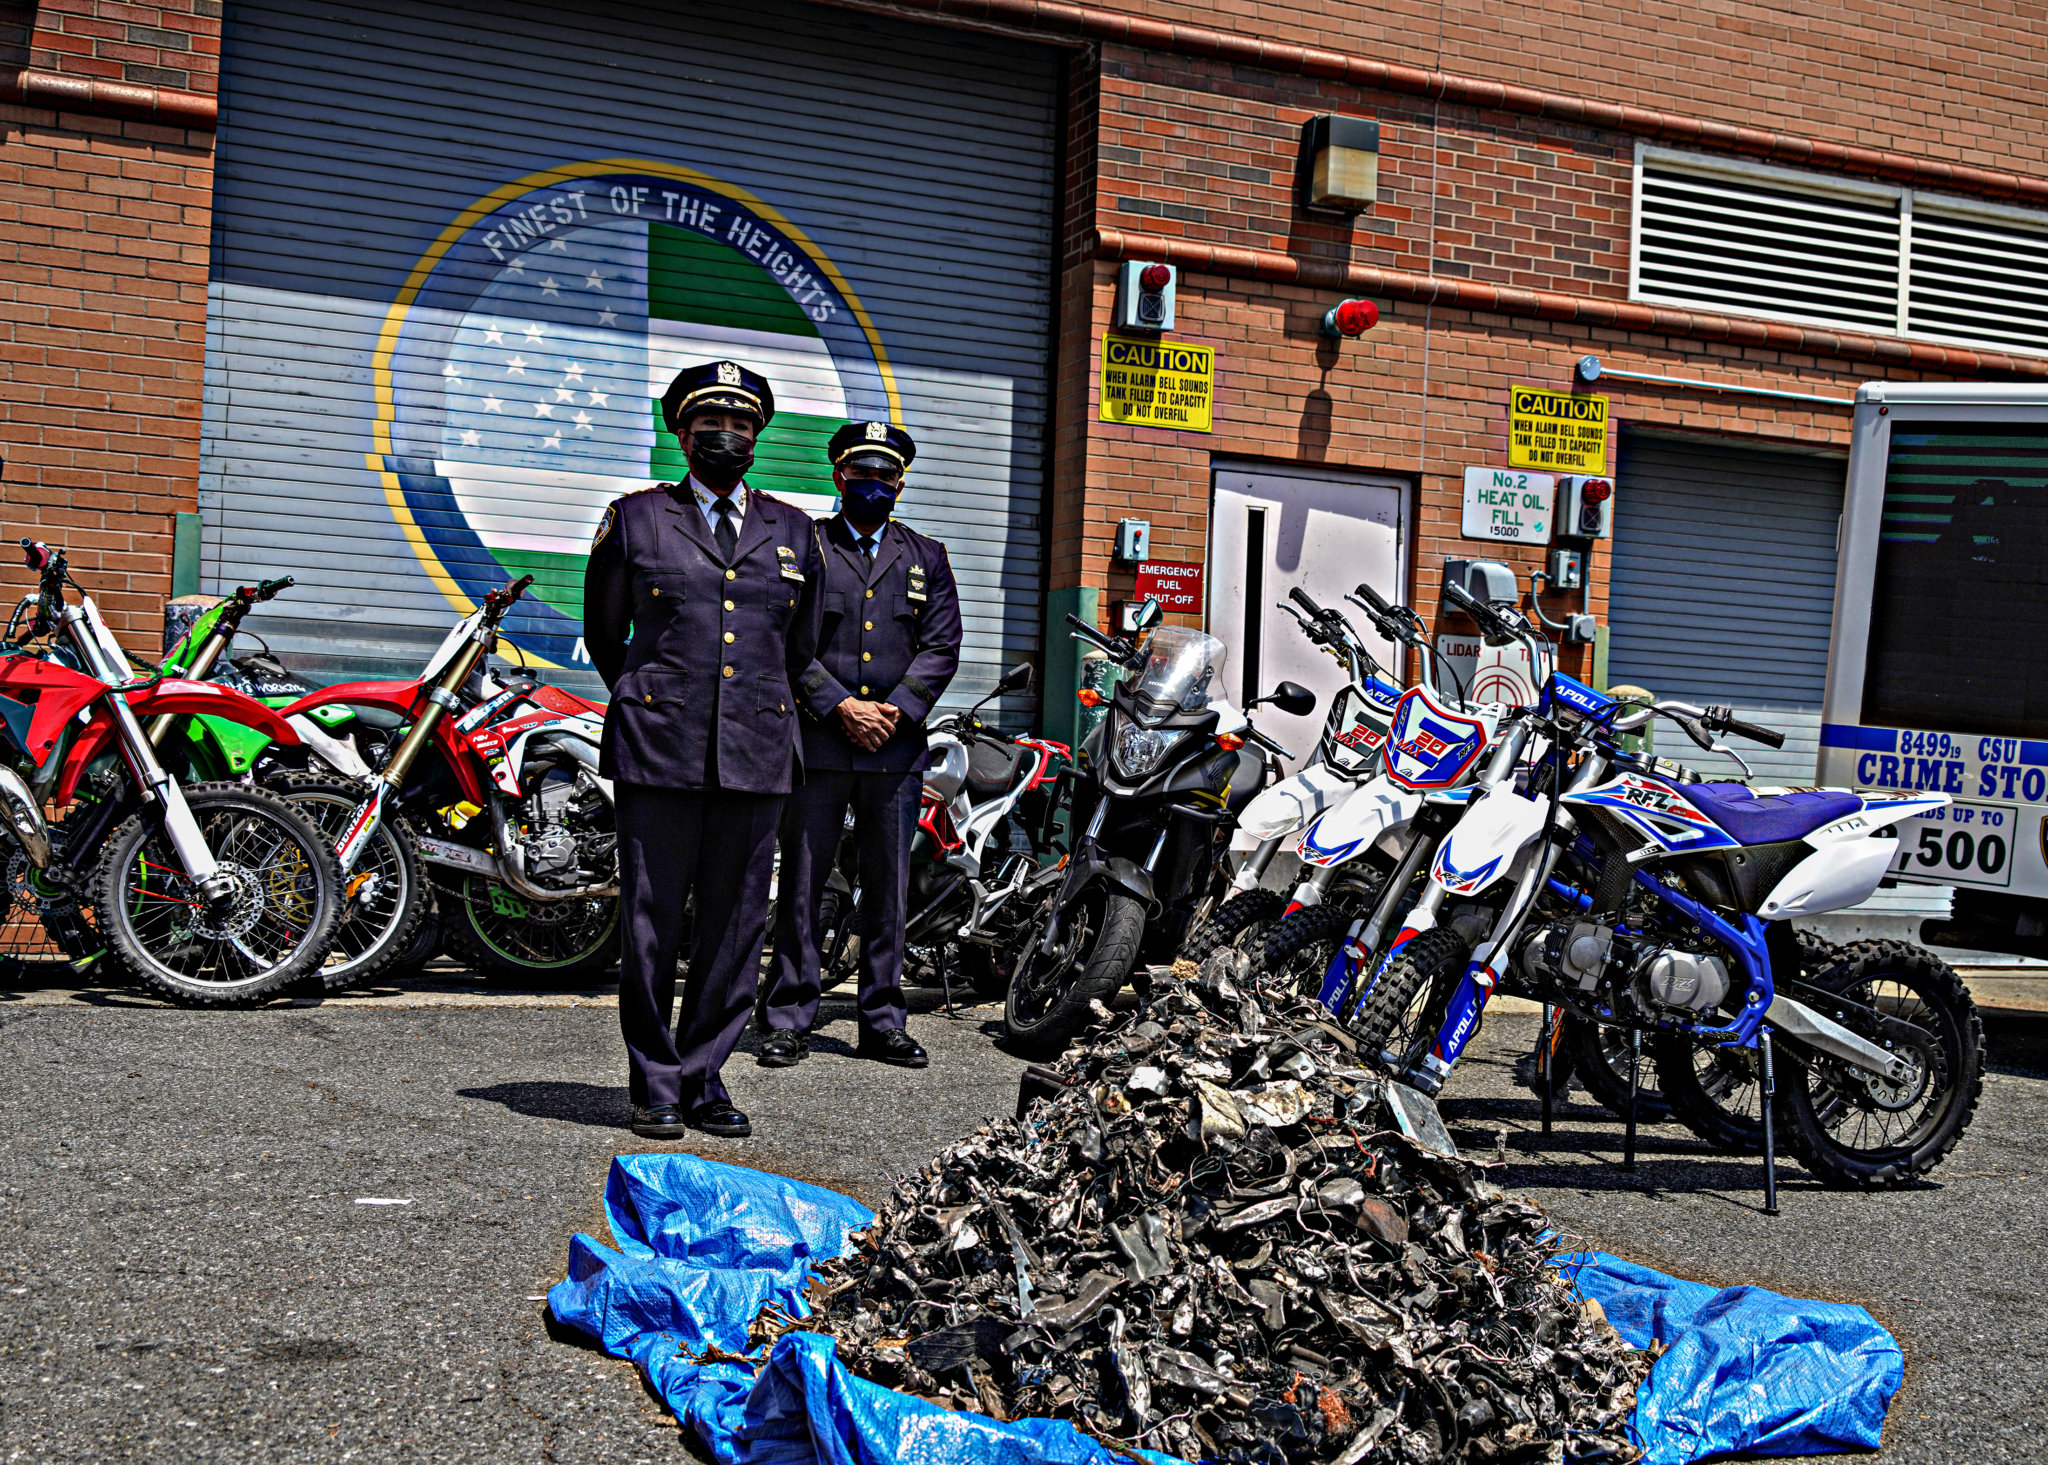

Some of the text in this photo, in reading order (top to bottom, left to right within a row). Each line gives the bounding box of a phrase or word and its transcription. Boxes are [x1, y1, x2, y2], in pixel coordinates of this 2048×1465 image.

[481, 186, 837, 323] FINEST OF THE HEIGHTS
[1109, 343, 1207, 373] CAUTION
[1106, 370, 1208, 394] WHEN ALARM BELL SOUNDS
[1106, 386, 1206, 409] TANK FILLED TO CAPACITY
[1517, 393, 1602, 421] CAUTION
[1123, 402, 1188, 422] DO NOT OVERFILL
[1514, 419, 1603, 440] WHEN ALARM BELL SOUNDS
[1515, 433, 1602, 454] TANK FILLED TO CAPACITY
[1528, 449, 1585, 467] DO NOT OVERFILL
[1478, 489, 1518, 507] HEAT
[1492, 509, 1524, 527] FILL
[1139, 564, 1200, 578] EMERGENCY
[1156, 579, 1182, 590] FUEL
[1143, 592, 1194, 605] SHUT-OFF
[1446, 642, 1482, 658] LIDAR
[1519, 648, 1549, 663] TT
[1333, 730, 1361, 749] MAX
[1396, 738, 1426, 759] MAX
[1413, 730, 1449, 756] 20
[1901, 730, 1951, 759] 8499
[1978, 737, 2017, 764] CSU
[1456, 739, 1475, 761] RFZ
[1857, 753, 2048, 802] CRIME STO
[1625, 787, 1670, 810] RFZ
[1953, 808, 1975, 824] UP
[1981, 810, 2004, 827] TO
[1302, 846, 1325, 860] RFZ
[1439, 871, 1468, 885] RFZ
